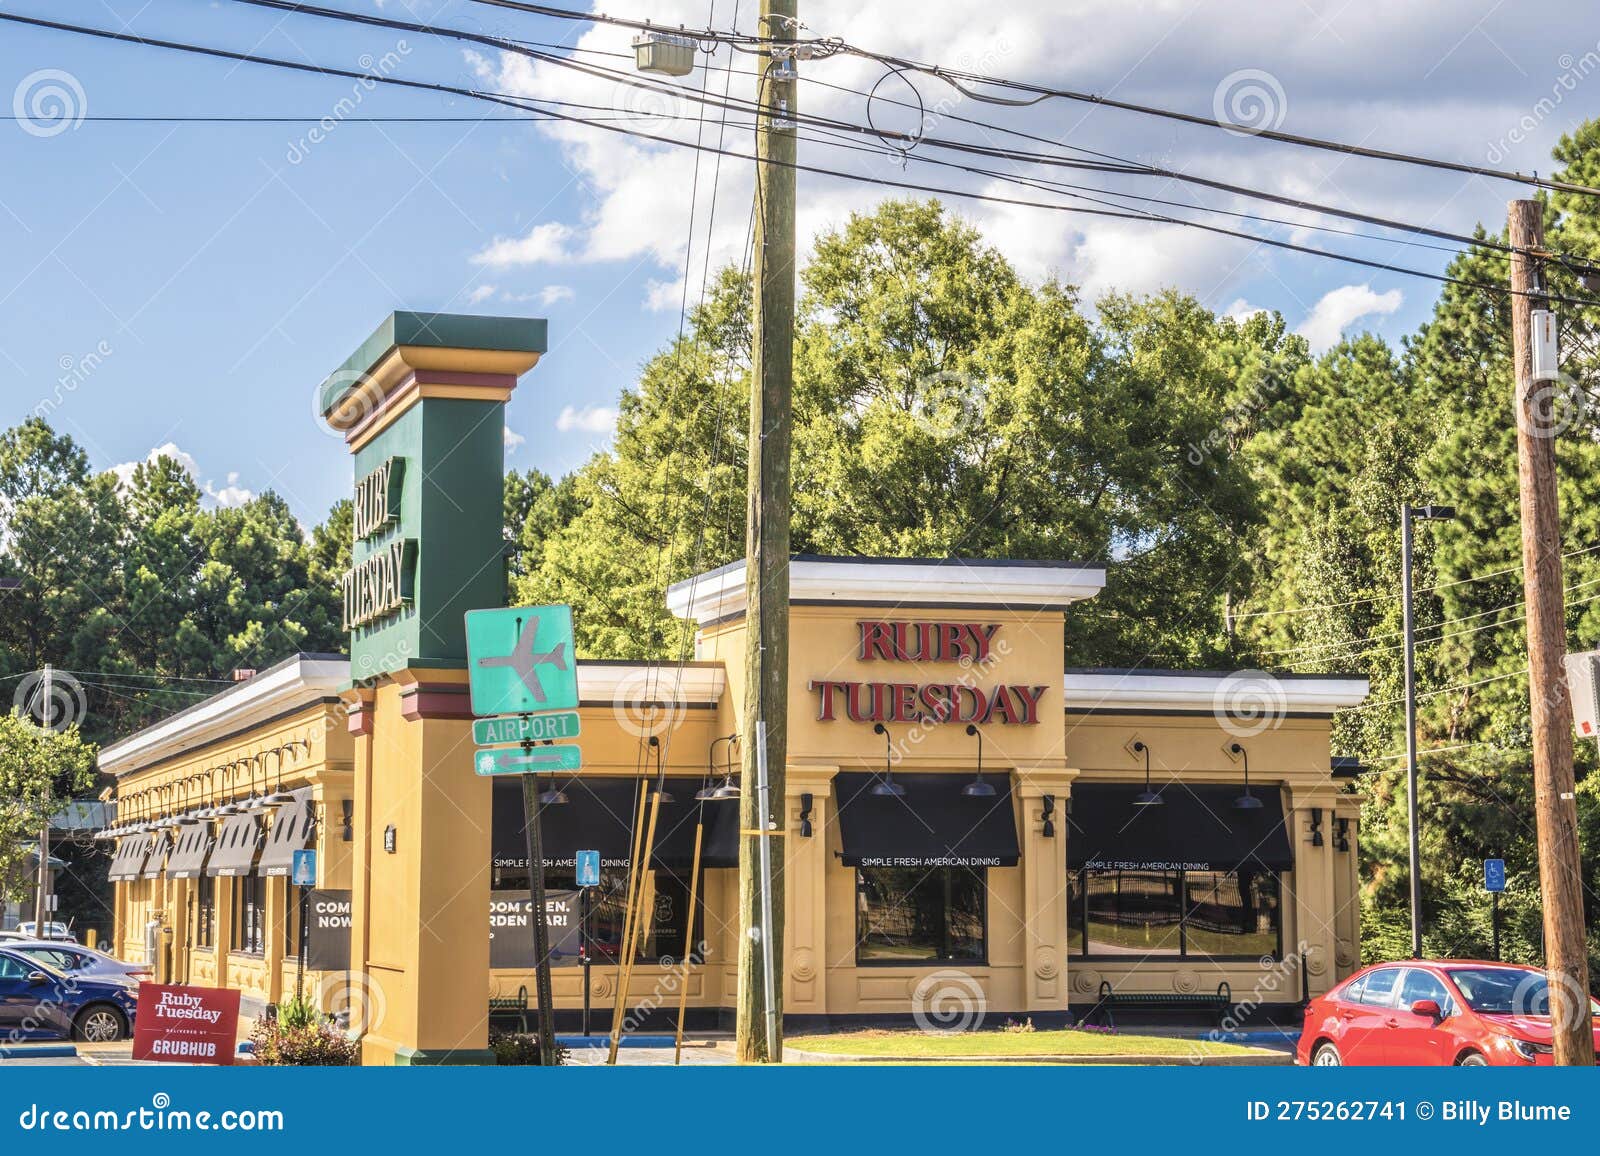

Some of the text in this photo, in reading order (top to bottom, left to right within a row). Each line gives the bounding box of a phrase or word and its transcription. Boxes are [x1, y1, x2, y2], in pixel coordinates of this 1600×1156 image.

[353, 456, 397, 541] RUBY
[342, 538, 408, 632] TUESDAY
[857, 621, 1002, 663] RUBY
[808, 680, 1049, 724] TUESDAY
[486, 715, 569, 742] AIRPORT
[494, 859, 523, 867] SIMPLE
[526, 859, 553, 867] FSH
[601, 859, 630, 867] DINING
[862, 857, 1000, 866] SIMPLE FRESH AMERICAN DINING
[1086, 861, 1209, 870] SIMPLE FRESH AMERICAN DINING
[316, 902, 352, 913] COM
[525, 901, 570, 913] OEN.
[546, 915, 568, 927] AR!
[160, 991, 202, 1010] Ruby
[155, 1004, 222, 1023] Tuesday
[152, 1039, 217, 1057] GRUBHUB
